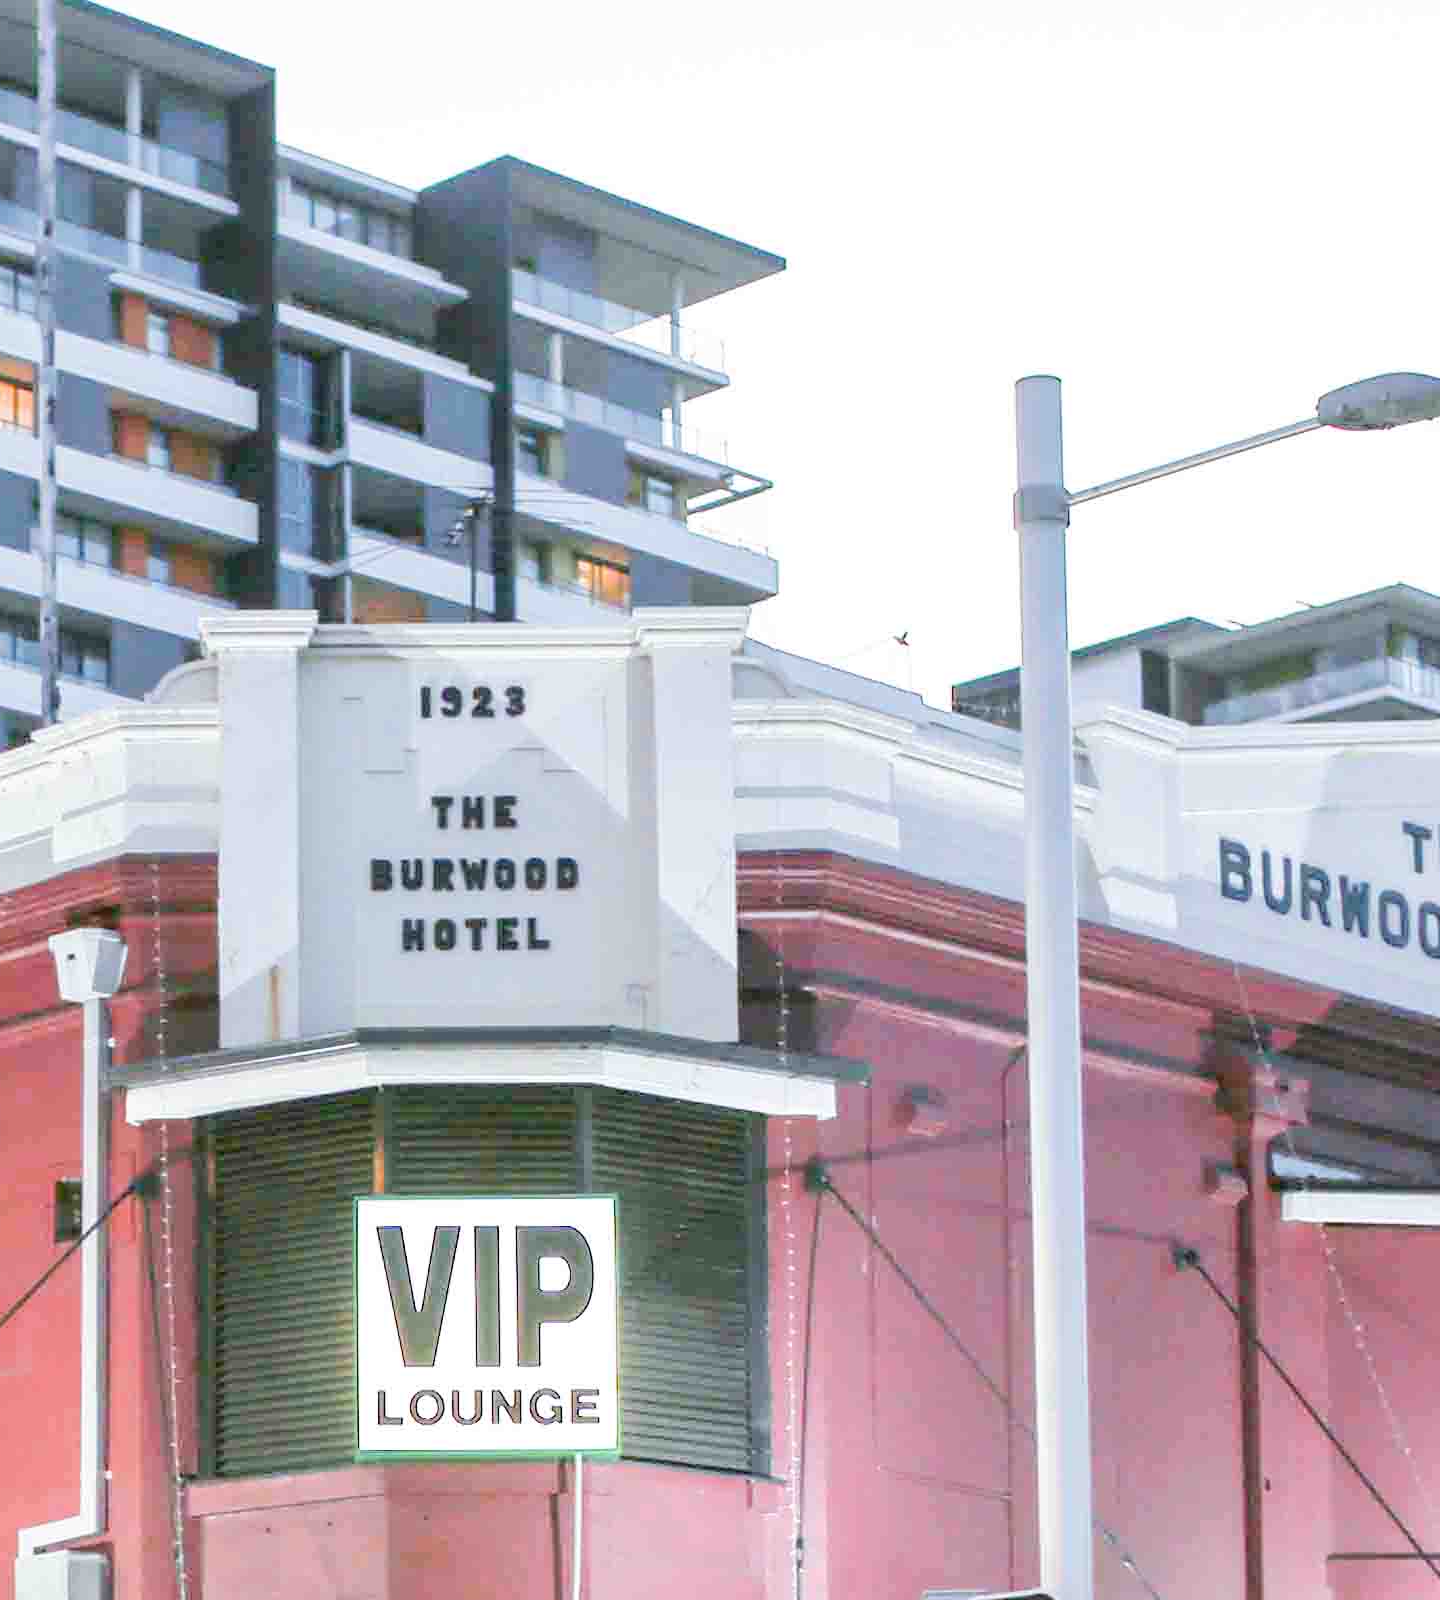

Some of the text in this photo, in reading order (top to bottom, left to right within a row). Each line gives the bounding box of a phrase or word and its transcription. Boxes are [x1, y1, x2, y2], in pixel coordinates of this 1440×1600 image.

[420, 686, 527, 719] 1923
[431, 796, 518, 829] THE
[369, 858, 581, 892] BURWOOD
[401, 918, 552, 952] HOTEL
[376, 1226, 594, 1367] VIP
[377, 1387, 600, 1426] LOUNGE
